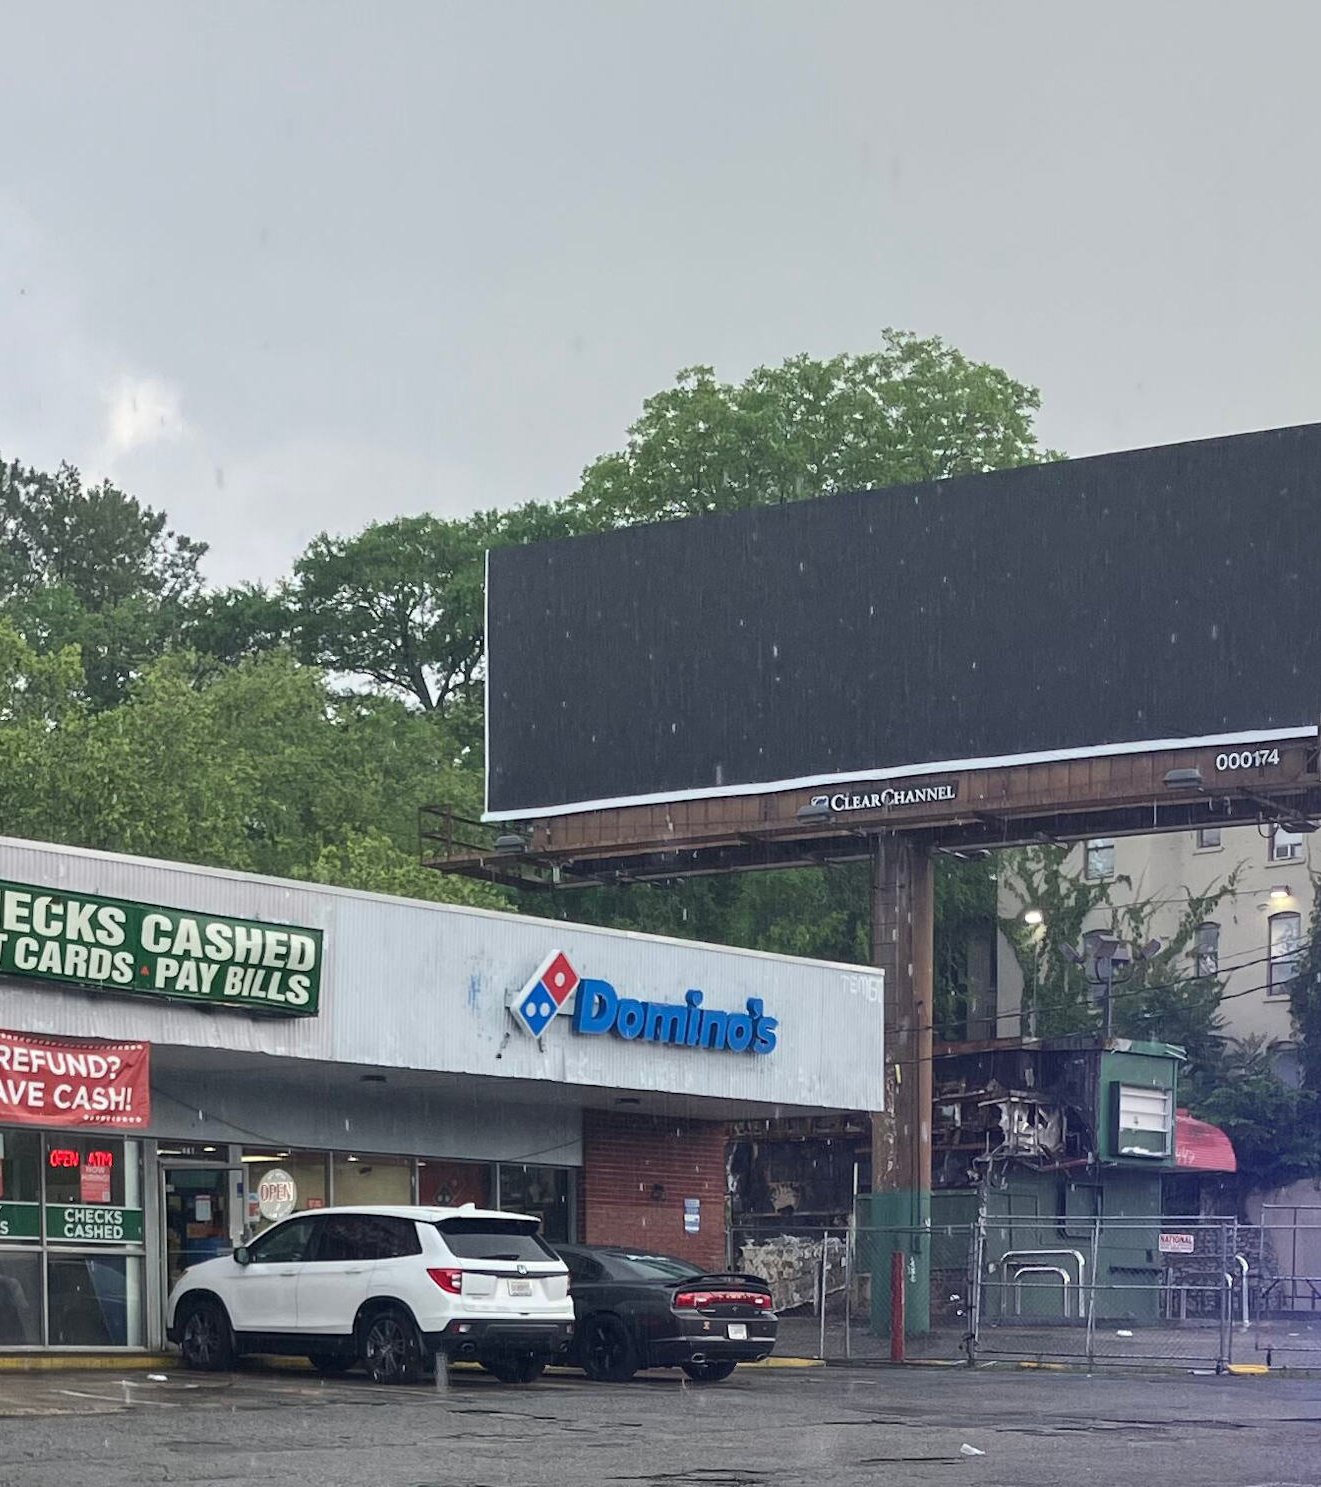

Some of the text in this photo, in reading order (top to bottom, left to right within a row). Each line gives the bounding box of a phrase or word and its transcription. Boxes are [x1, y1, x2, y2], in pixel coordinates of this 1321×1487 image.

[1215, 748, 1280, 772] 000174
[141, 912, 316, 972] CASHED
[14, 935, 135, 984] CARDS
[154, 957, 224, 993] PAY
[223, 965, 310, 1005] BILLS
[574, 977, 778, 1055] Domino's
[53, 1083, 133, 1112] CASH!
[49, 1149, 79, 1168] OPEN
[88, 1151, 114, 1168] ATM
[260, 1181, 296, 1201] OPEN
[63, 1208, 124, 1225] CHECKS
[63, 1223, 124, 1240] CASHED
